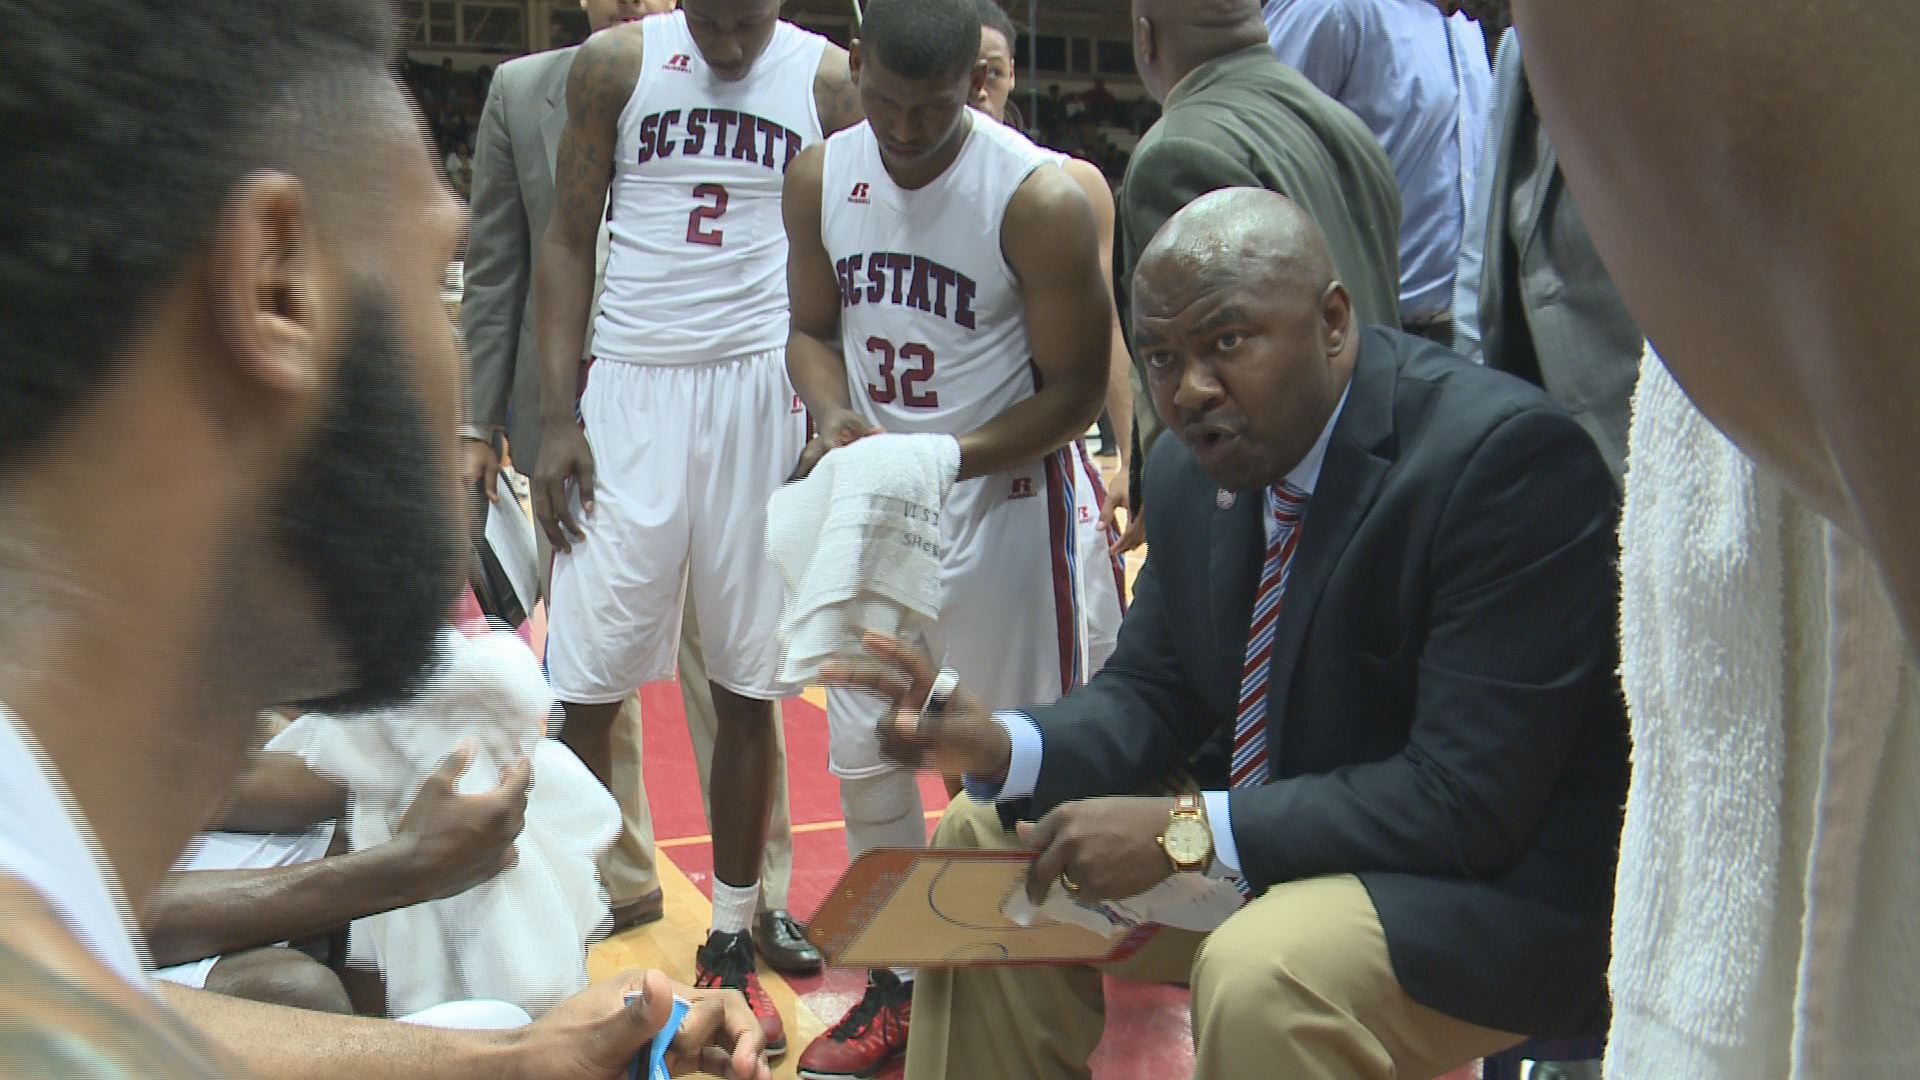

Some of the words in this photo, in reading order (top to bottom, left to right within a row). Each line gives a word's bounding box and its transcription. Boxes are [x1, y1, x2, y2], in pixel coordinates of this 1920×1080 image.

[638, 109, 681, 166] SC
[686, 183, 729, 247] 2
[836, 253, 863, 308] SC
[867, 252, 976, 330] STATE
[866, 336, 938, 408] 32
